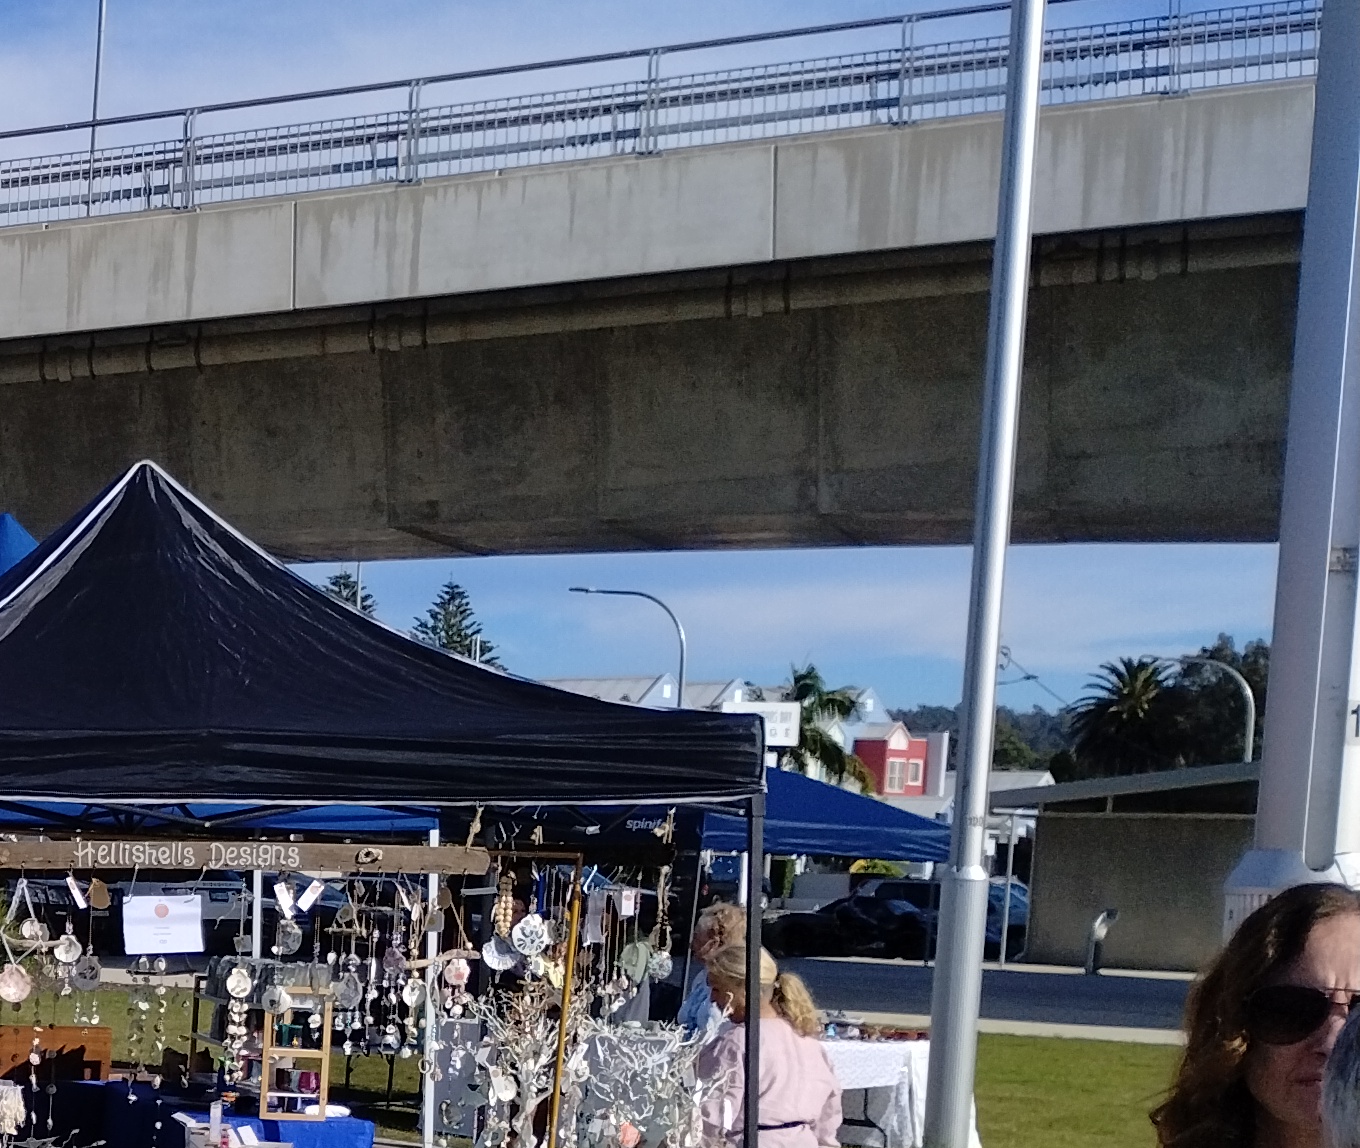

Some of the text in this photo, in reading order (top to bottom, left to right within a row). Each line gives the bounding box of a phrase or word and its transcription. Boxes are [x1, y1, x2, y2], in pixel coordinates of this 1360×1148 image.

[625, 817, 677, 832] spinif
[73, 841, 302, 868] Hellishells Designs
